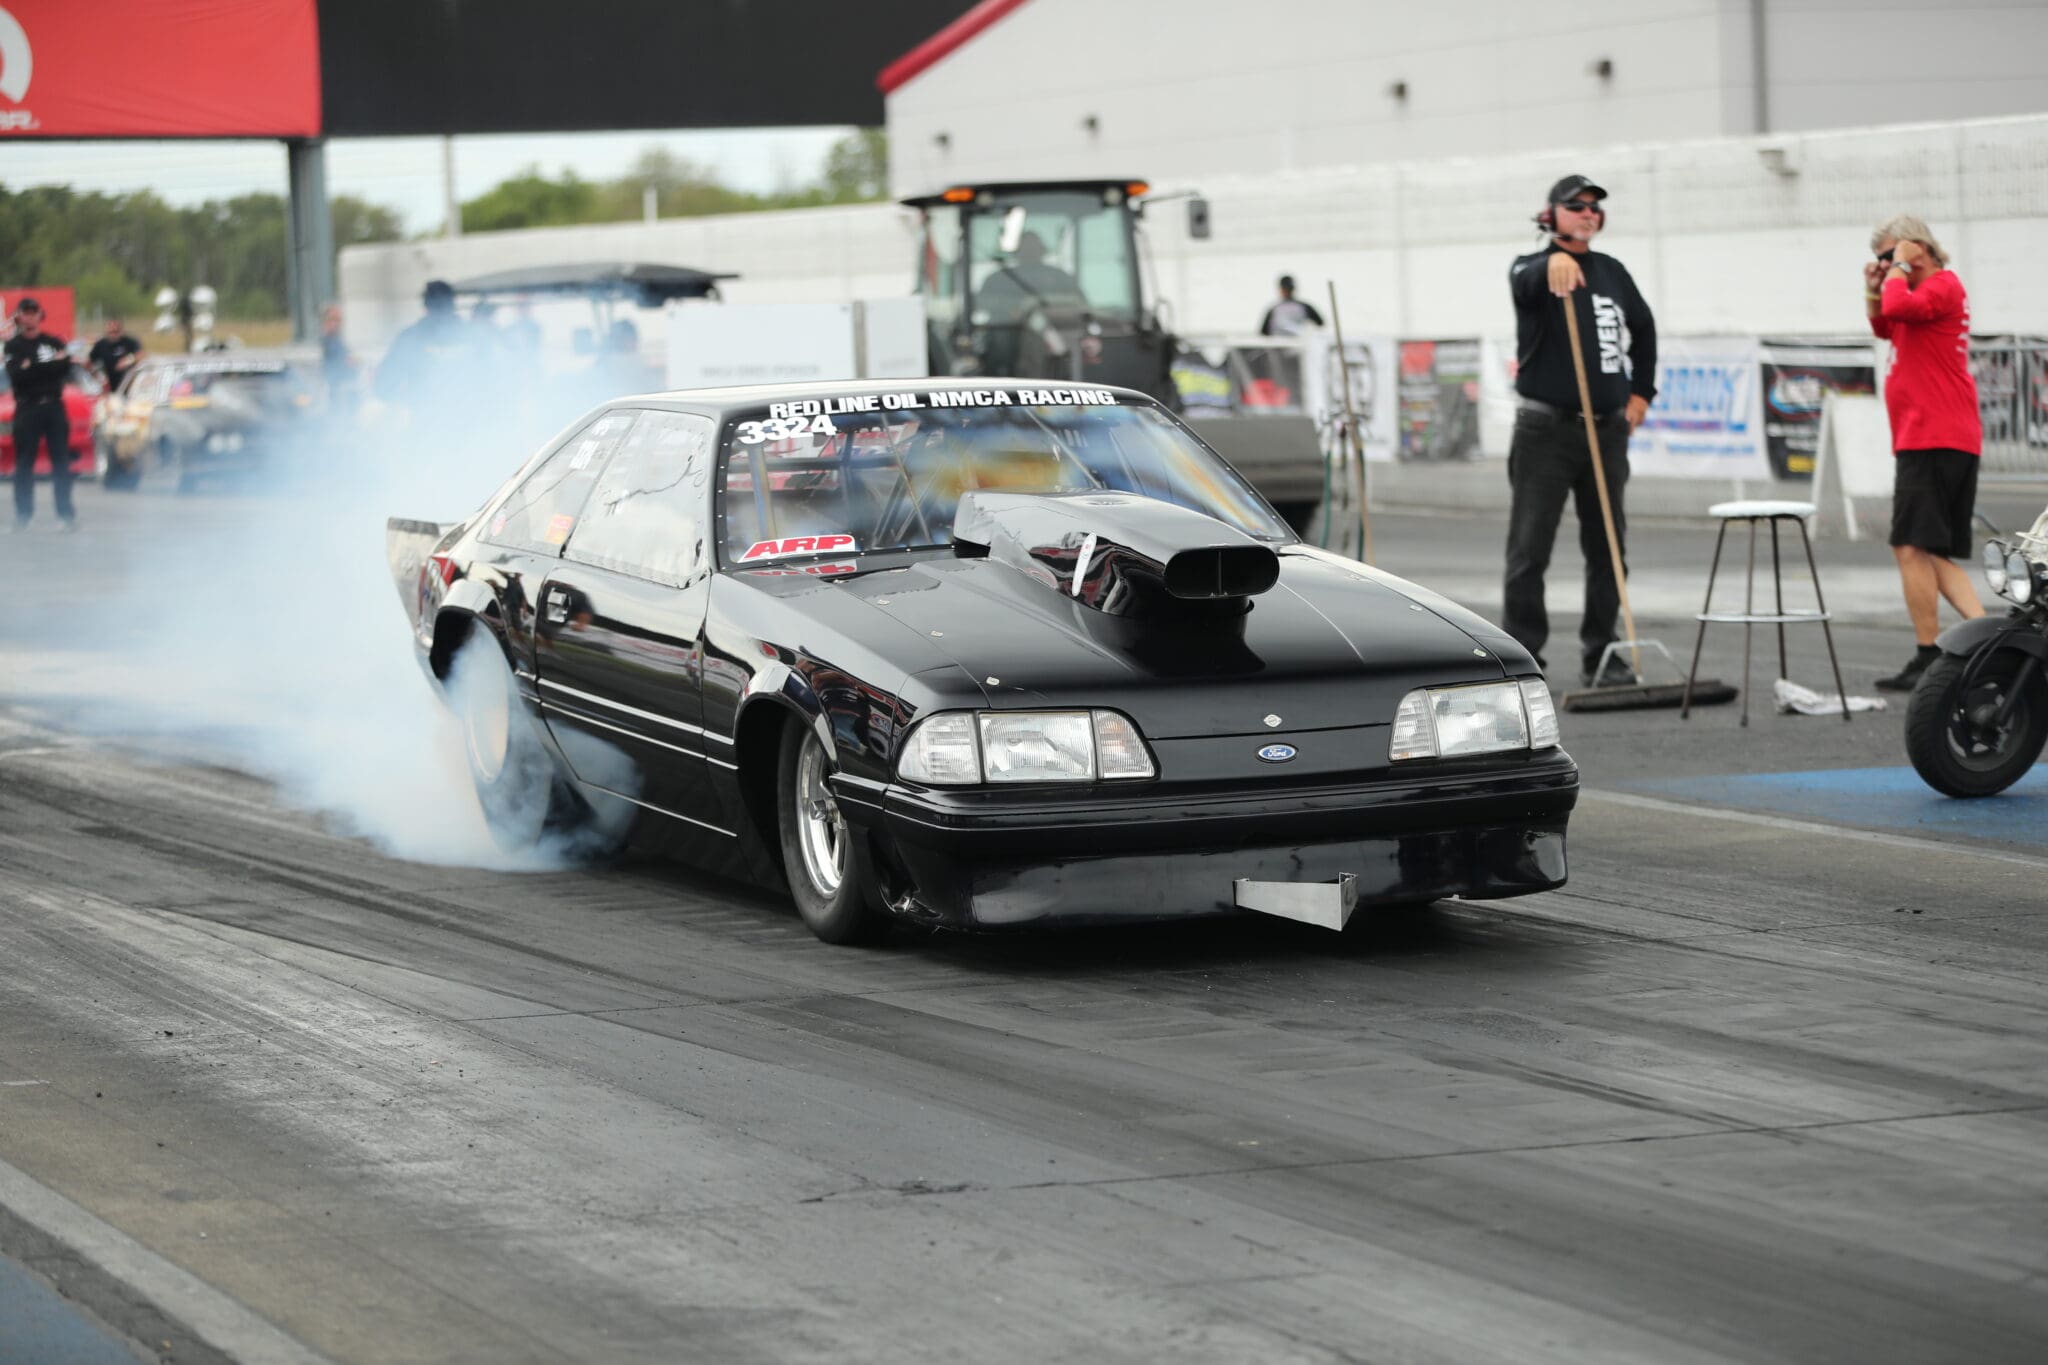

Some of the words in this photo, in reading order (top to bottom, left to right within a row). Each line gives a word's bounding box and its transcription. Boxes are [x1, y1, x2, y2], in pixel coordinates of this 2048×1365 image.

[1592, 293, 1620, 373] EVENT
[769, 401, 821, 419] RED
[823, 395, 881, 414] LINE
[881, 393, 926, 410] OIL
[928, 390, 1013, 408] NMCA
[737, 415, 837, 445] 3324
[743, 536, 852, 558] ARP
